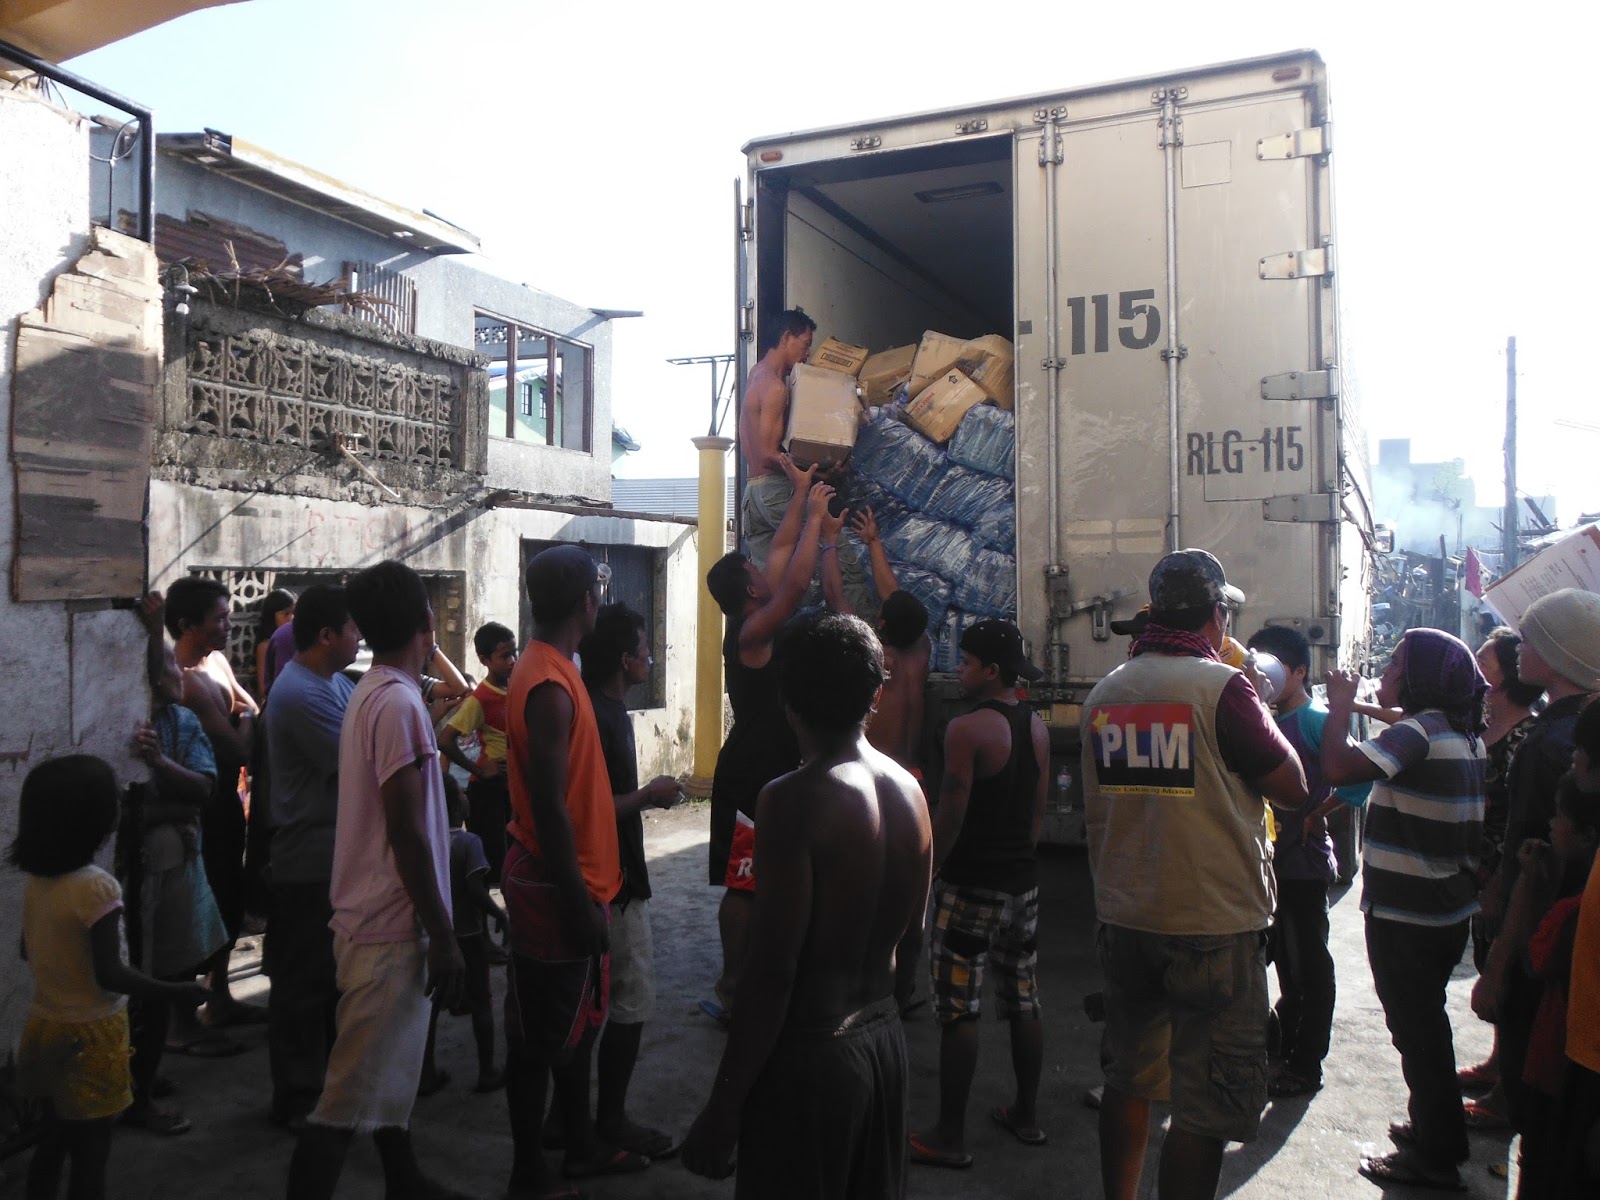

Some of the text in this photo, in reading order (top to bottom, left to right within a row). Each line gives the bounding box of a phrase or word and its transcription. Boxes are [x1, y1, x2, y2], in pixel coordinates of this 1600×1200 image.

[1067, 289, 1161, 356] 115
[1100, 722, 1190, 769] PLM
[1162, 786, 1192, 794] Masa
